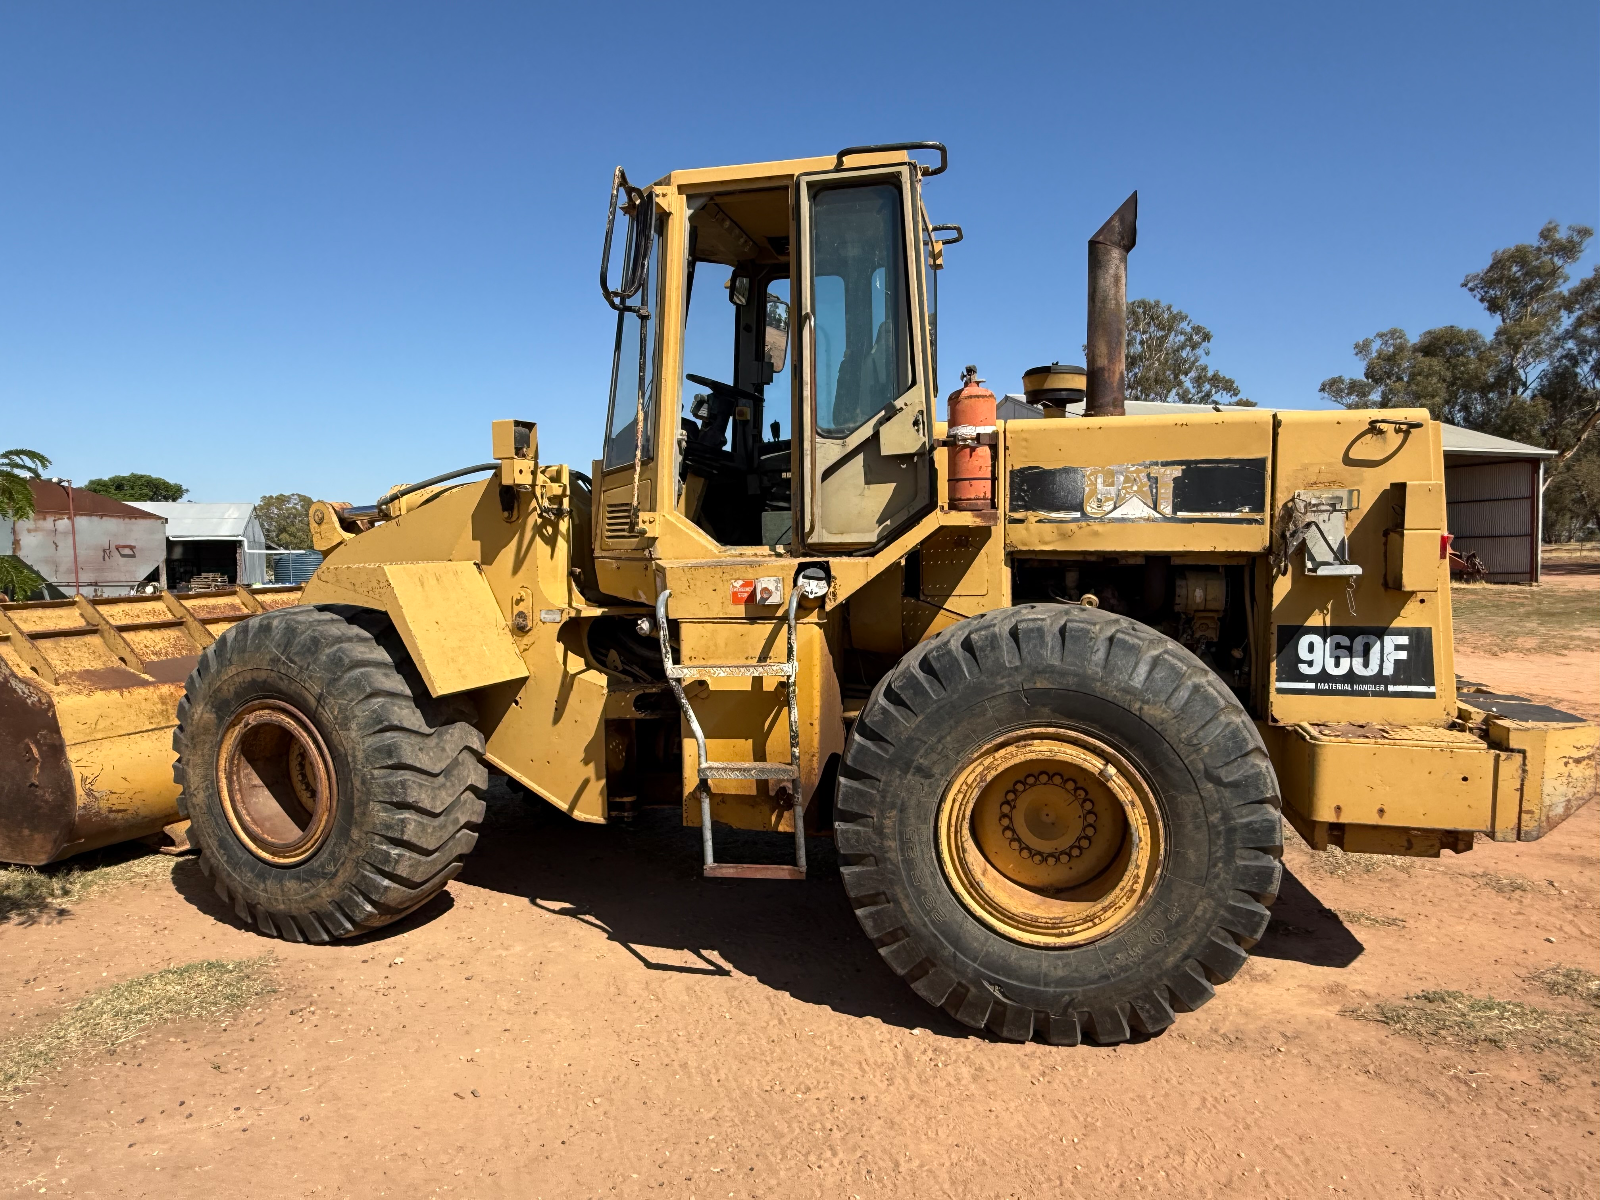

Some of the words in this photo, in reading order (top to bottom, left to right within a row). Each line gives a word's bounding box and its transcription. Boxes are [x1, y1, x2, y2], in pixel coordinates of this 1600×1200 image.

[1083, 466, 1183, 518] CAT
[1297, 634, 1410, 676] 960F
[1317, 682, 1352, 691] MATERIAL
[1353, 684, 1385, 692] HANDLER
